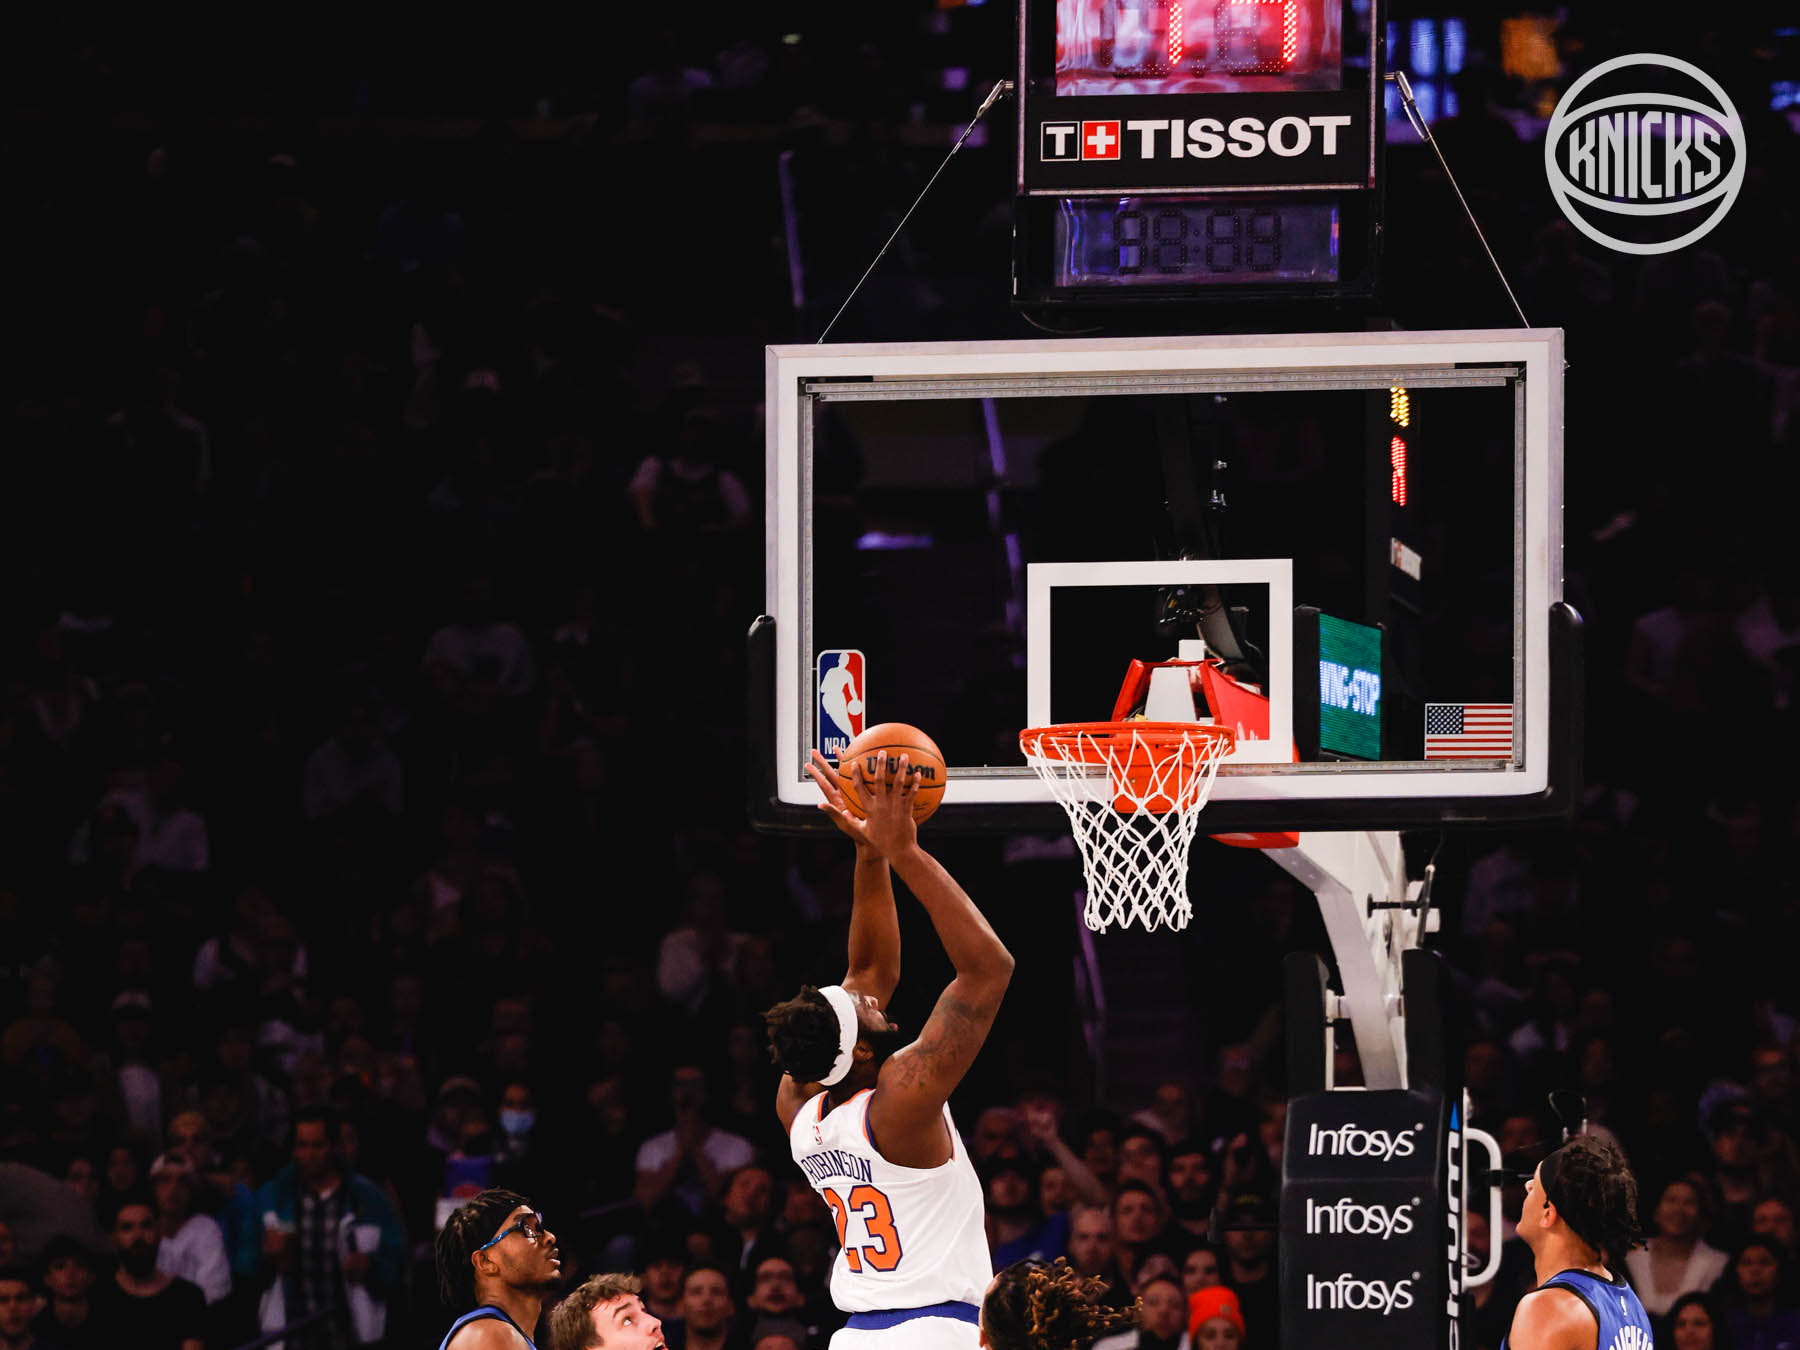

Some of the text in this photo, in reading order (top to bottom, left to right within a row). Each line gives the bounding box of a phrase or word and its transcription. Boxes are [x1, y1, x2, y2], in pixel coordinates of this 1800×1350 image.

[1127, 115, 1351, 159] TISSOT
[866, 756, 936, 781] Wison
[1308, 1123, 1415, 1162] Infosys
[801, 1150, 872, 1184] ROBINSON
[823, 1184, 903, 1273] 23
[1306, 1197, 1413, 1240] Infosys
[1307, 1272, 1413, 1316] Infosys
